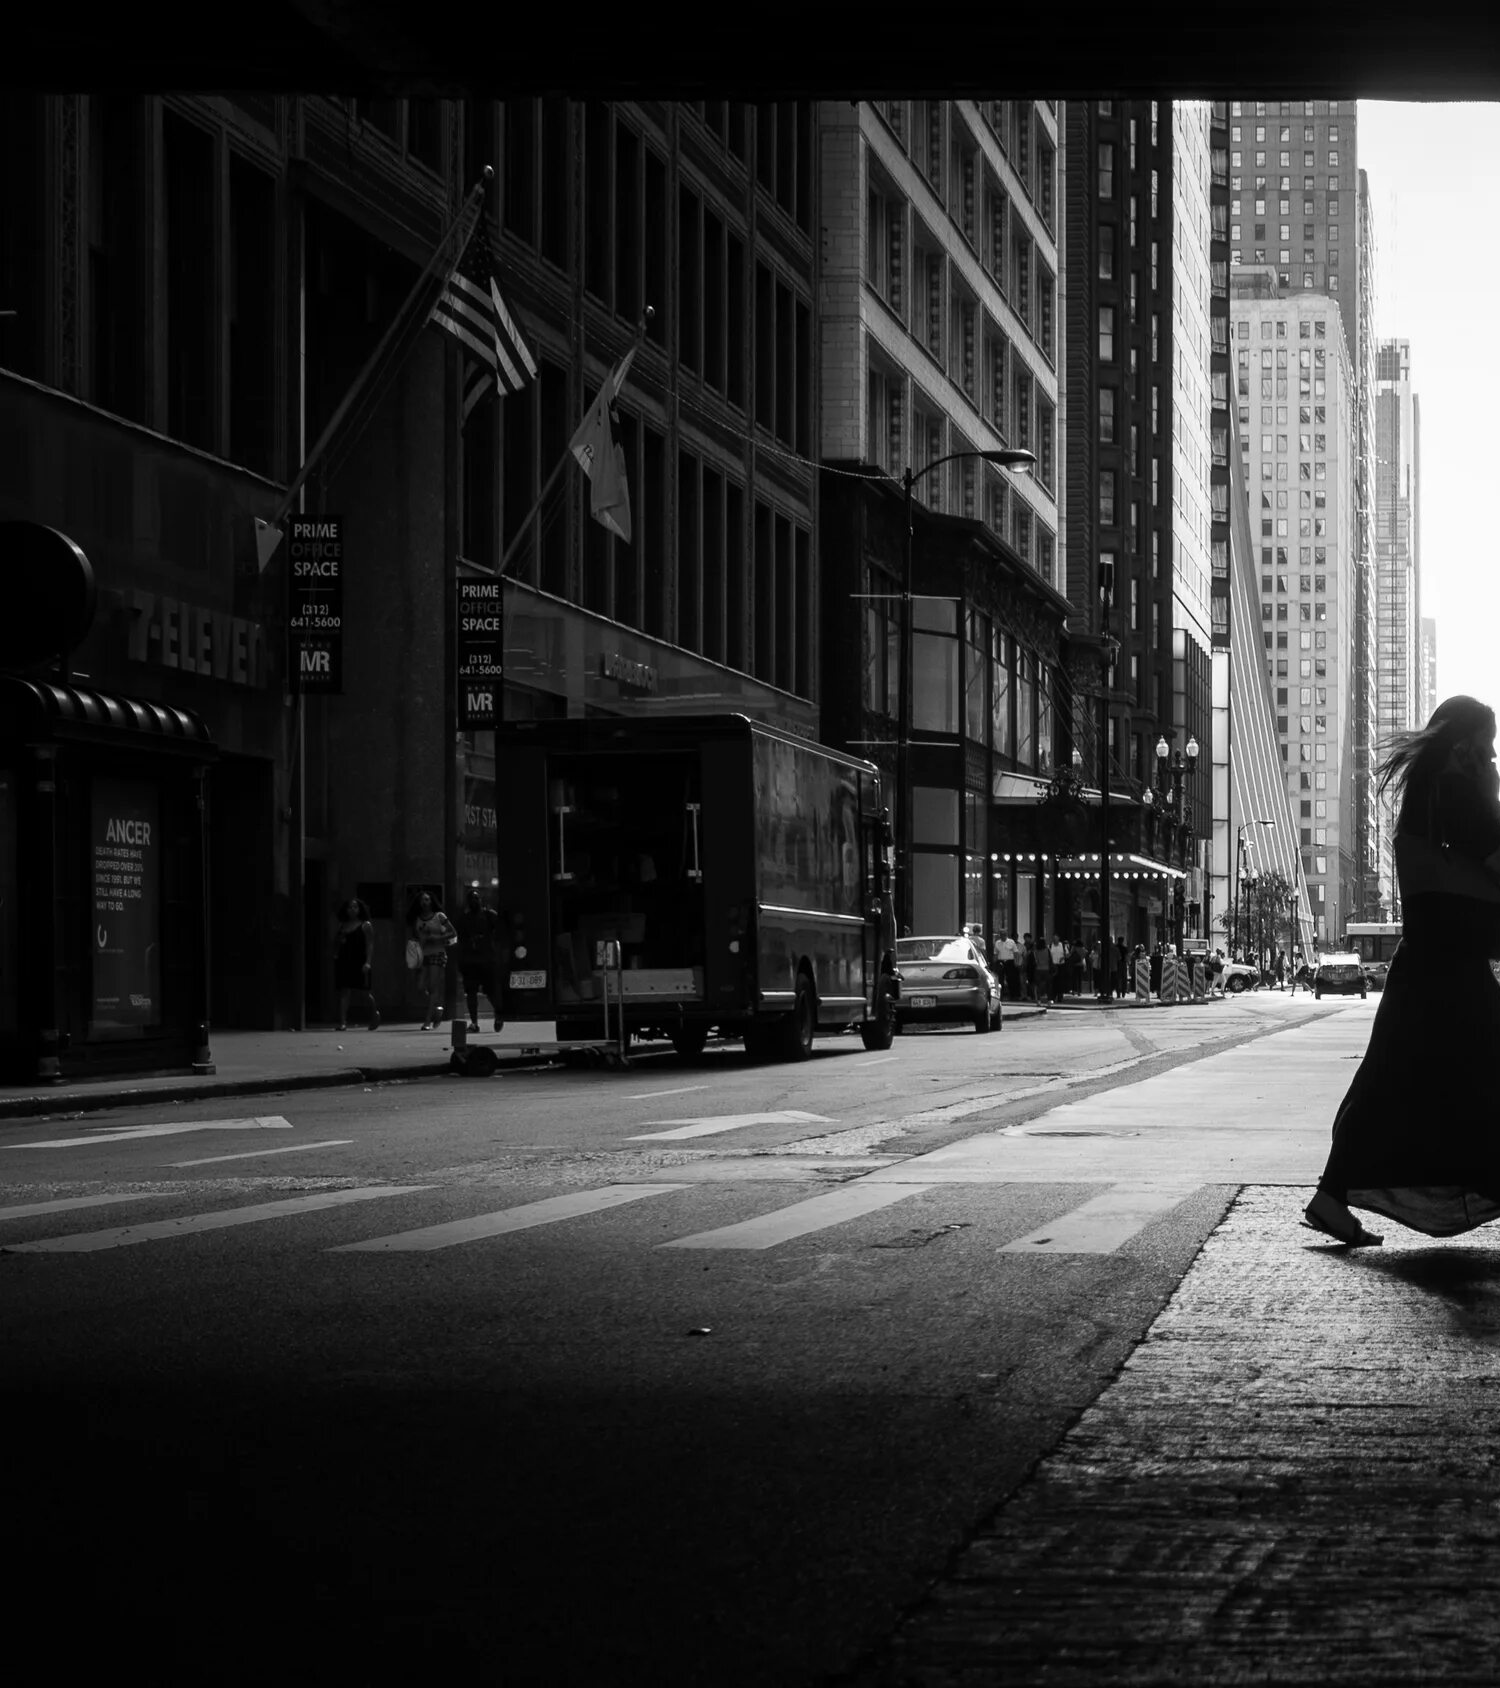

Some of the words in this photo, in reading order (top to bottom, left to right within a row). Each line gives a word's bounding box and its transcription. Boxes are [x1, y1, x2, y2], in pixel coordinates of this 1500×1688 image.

[293, 523, 339, 539] PRIME
[290, 542, 342, 558] OFFICE
[293, 561, 339, 577] SPACE
[461, 584, 499, 598] PRIME
[302, 603, 329, 616] (312)
[460, 601, 502, 614] OFFICE
[461, 617, 500, 631] SPACE
[468, 654, 492, 665] (312)
[459, 665, 502, 675] 641-5600
[106, 818, 151, 846] ANCER
